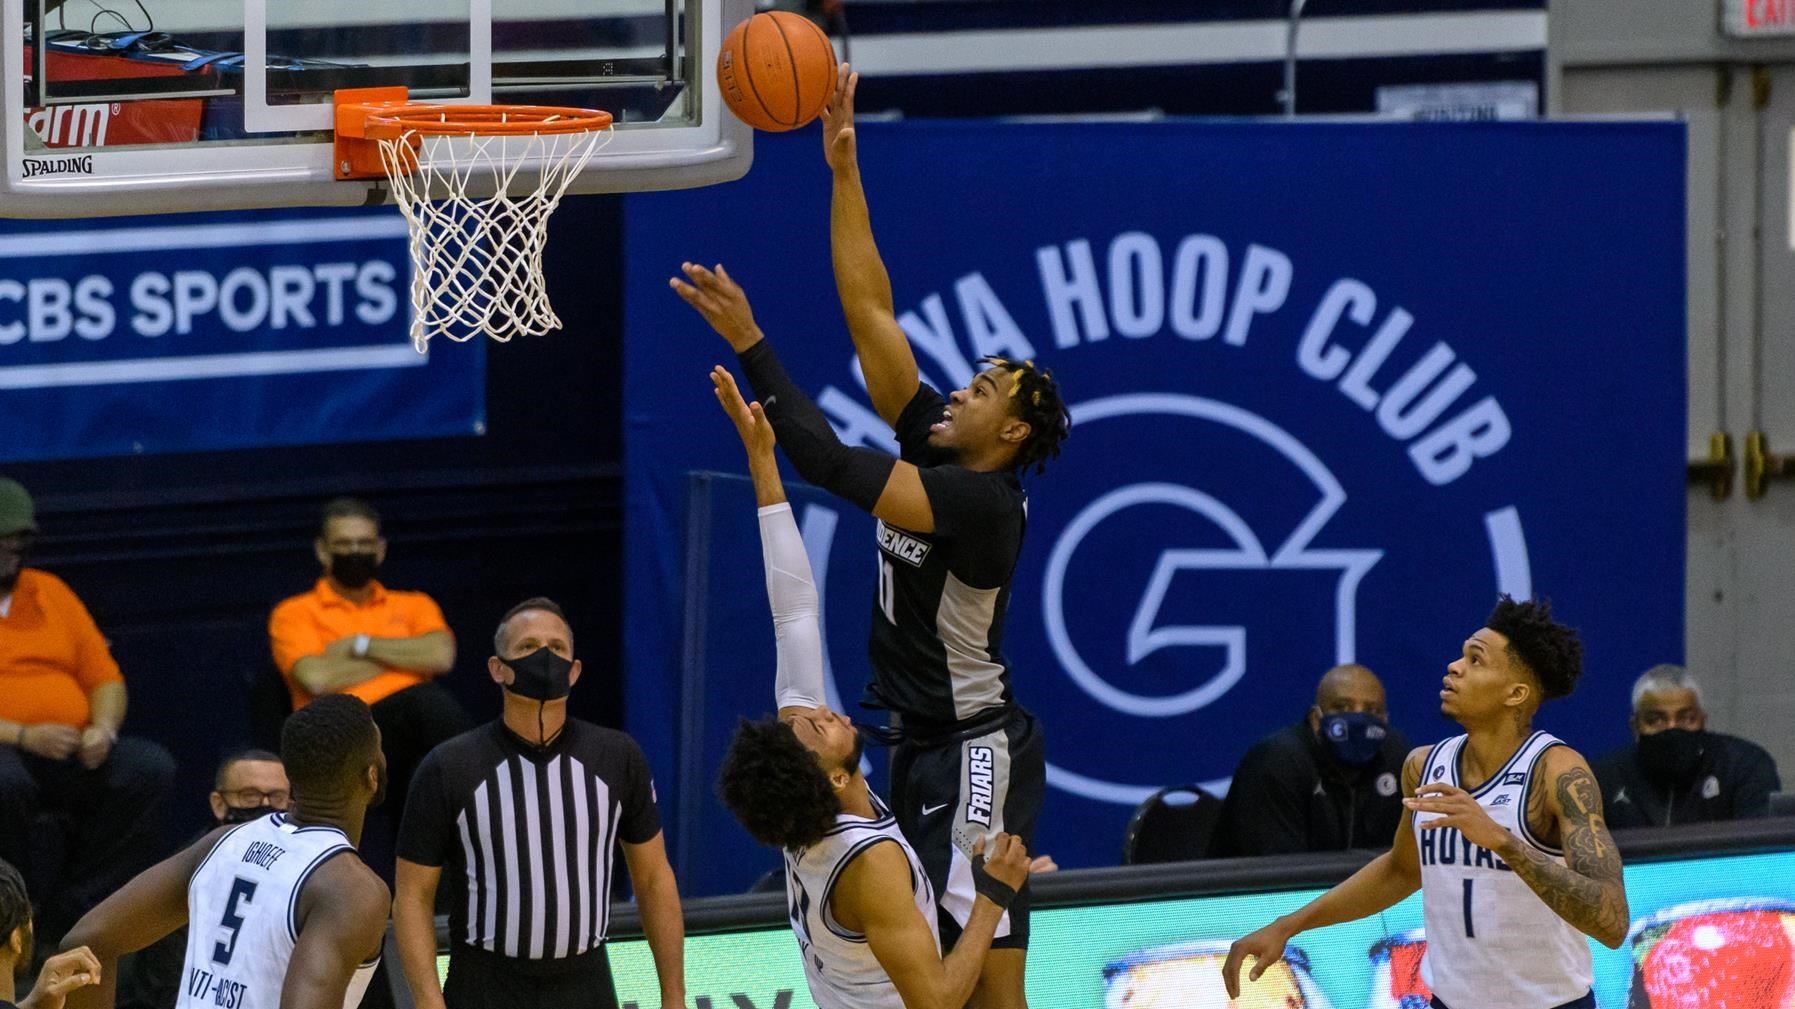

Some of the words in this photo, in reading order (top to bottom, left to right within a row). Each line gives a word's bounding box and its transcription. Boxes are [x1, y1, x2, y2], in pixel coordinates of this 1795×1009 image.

[22, 155, 93, 178] SPALDING
[130, 260, 397, 337] SPORTS
[1036, 231, 1293, 348] HOOP
[1296, 277, 1512, 486] CLUB
[966, 746, 993, 830] FRIARS
[212, 876, 258, 966] 5
[1463, 878, 1475, 938] 1
